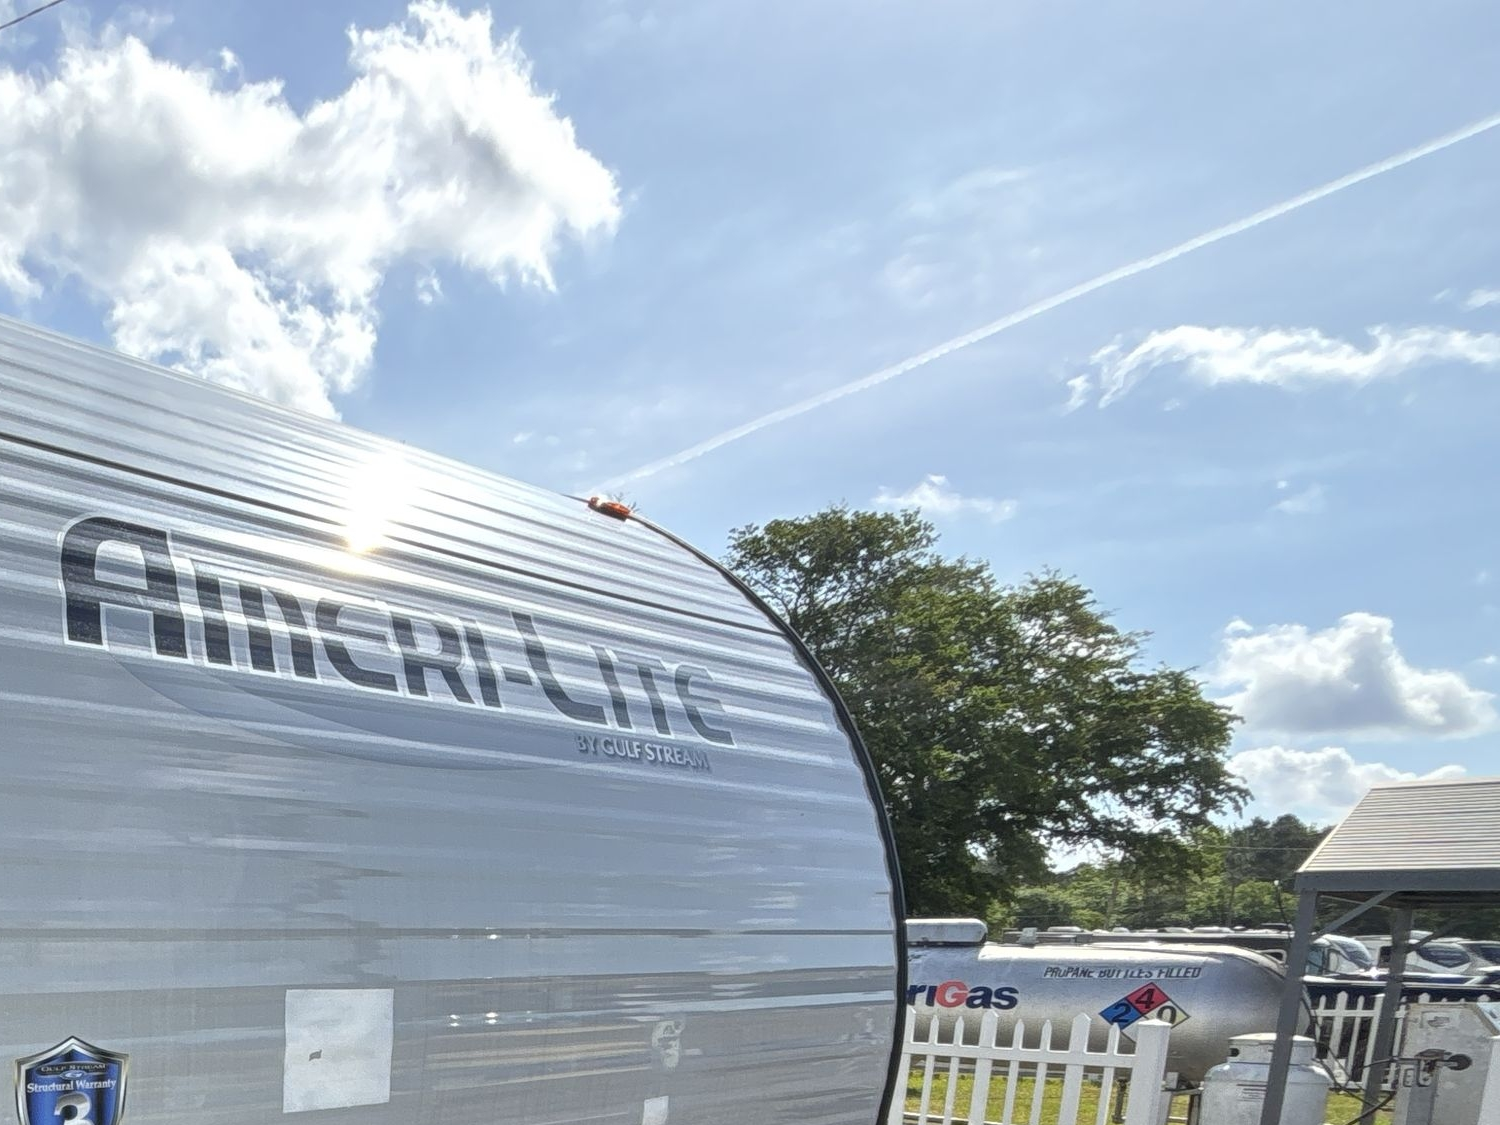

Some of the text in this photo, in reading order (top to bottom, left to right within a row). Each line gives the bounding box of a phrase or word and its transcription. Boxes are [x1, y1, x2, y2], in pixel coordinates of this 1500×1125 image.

[575, 735, 711, 769] BY GULF STREAM
[1157, 967, 1202, 979] FILLED
[906, 979, 1020, 1010] riGas
[1135, 988, 1155, 1009] 4
[1111, 1002, 1132, 1023] 2
[1157, 1004, 1178, 1025] 0
[27, 1079, 117, 1093] Structural Warranty
